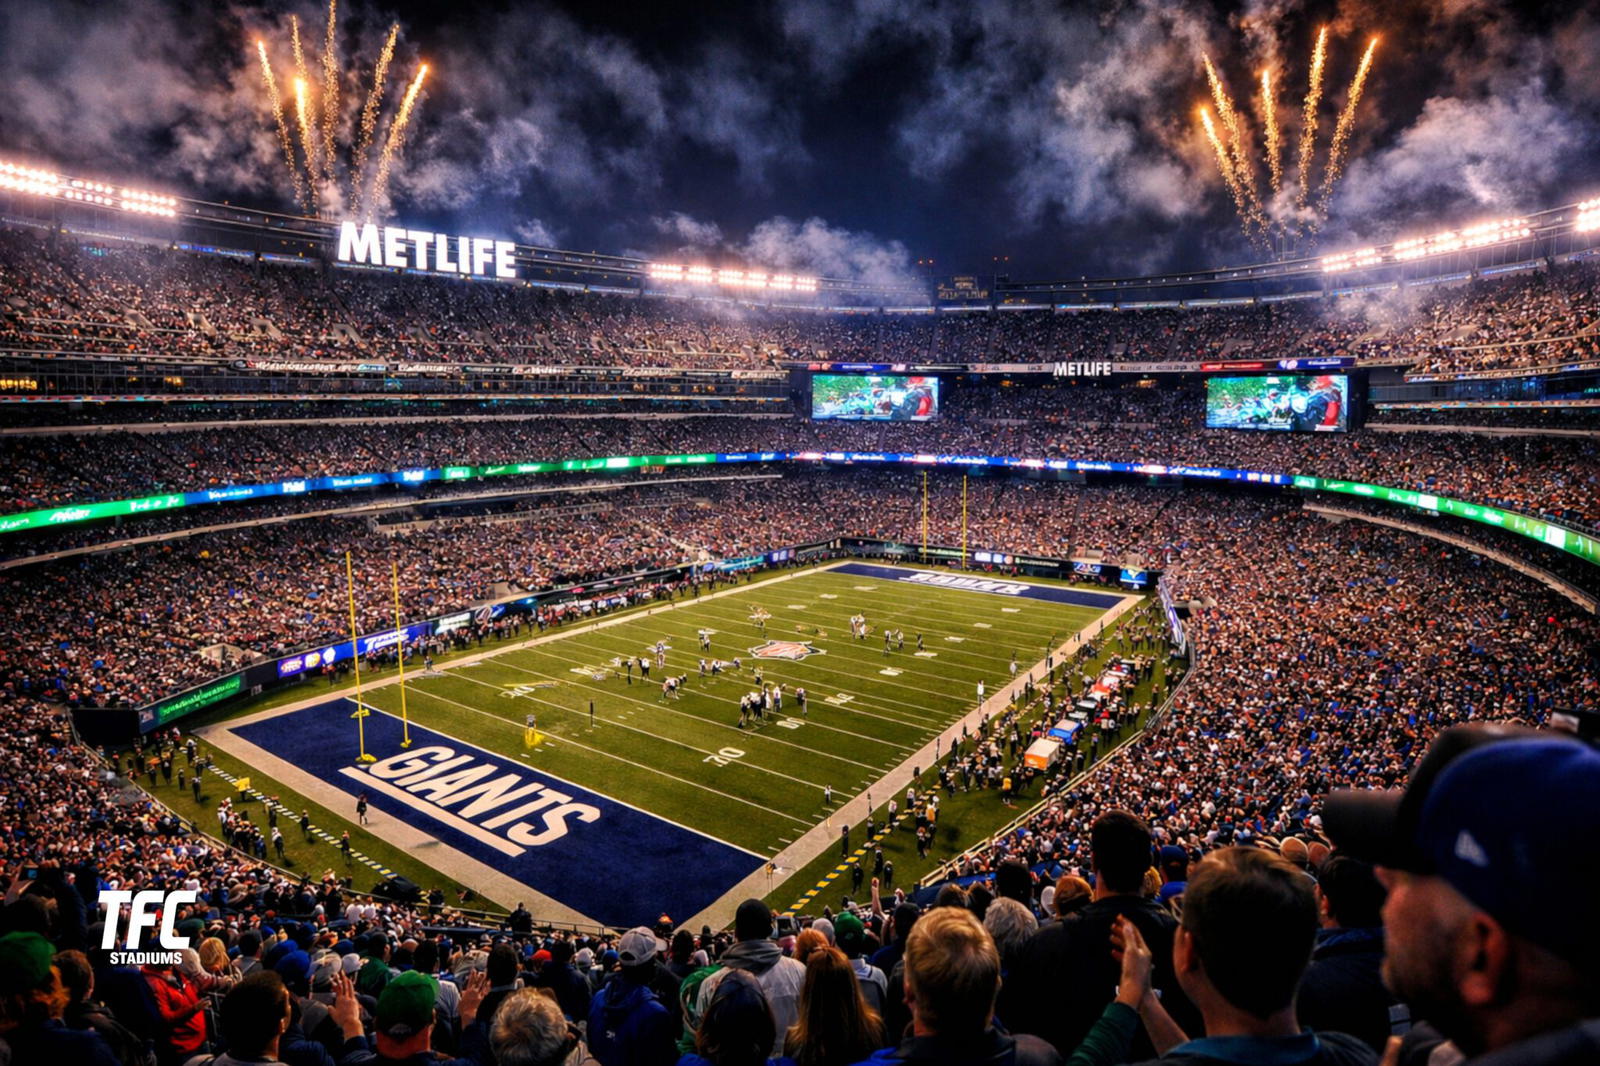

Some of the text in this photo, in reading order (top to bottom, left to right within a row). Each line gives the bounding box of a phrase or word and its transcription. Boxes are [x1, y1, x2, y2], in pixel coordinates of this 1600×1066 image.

[337, 221, 516, 278] METLIFE
[1053, 361, 1112, 377] METLIFE
[368, 746, 600, 846] GIANTS
